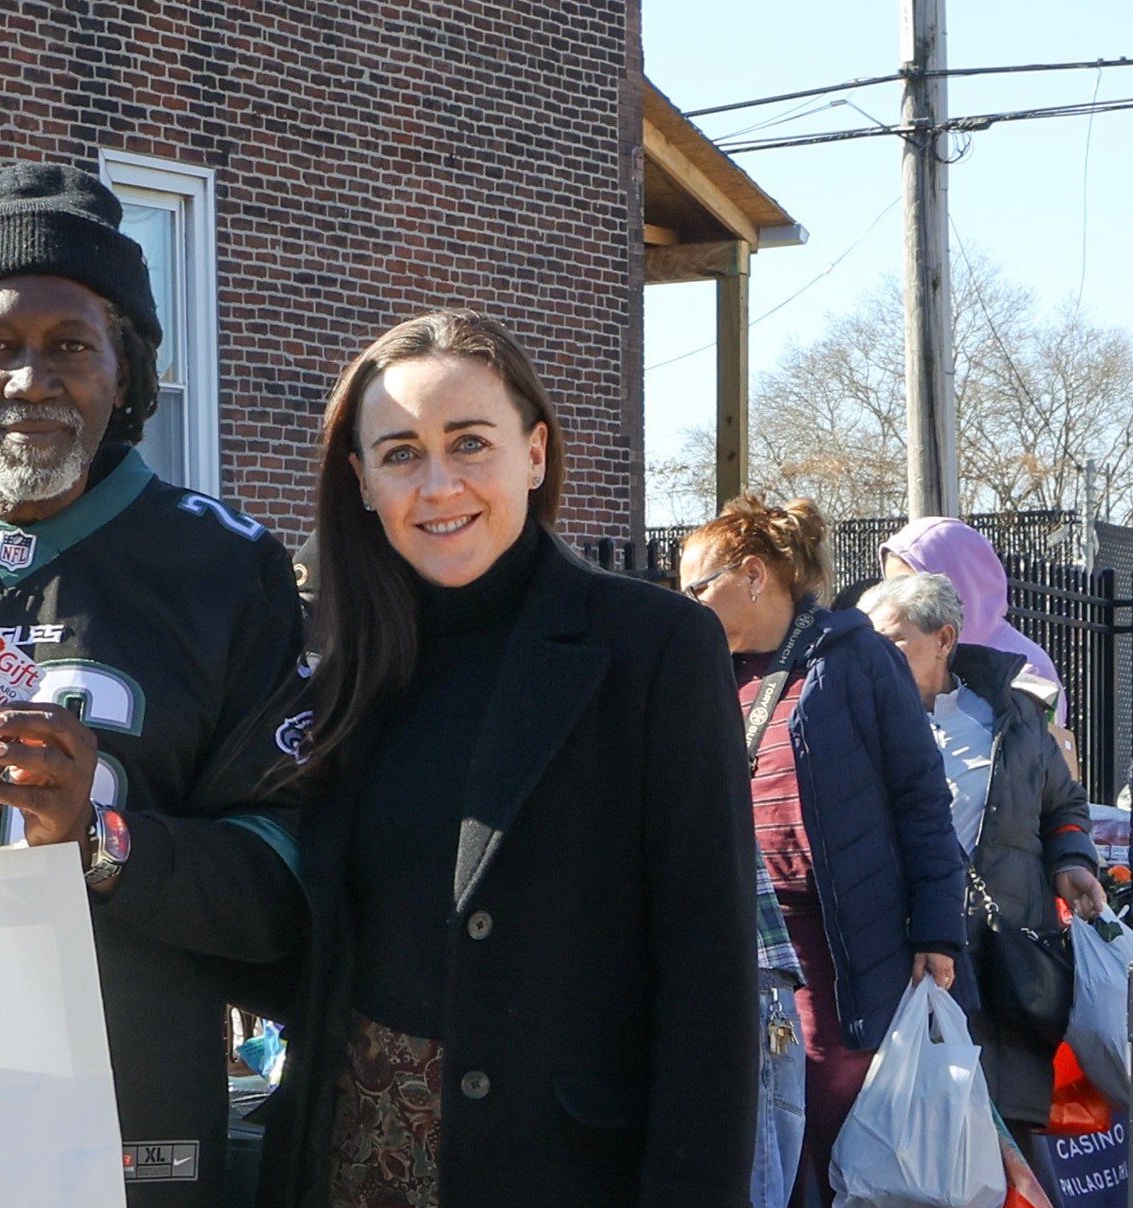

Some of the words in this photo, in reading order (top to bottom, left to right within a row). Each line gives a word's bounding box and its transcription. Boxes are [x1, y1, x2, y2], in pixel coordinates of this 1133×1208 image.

[2, 548, 27, 562] NFL
[779, 628, 802, 664] BURCH
[762, 682, 776, 708] TORY
[746, 725, 757, 747] BUR
[1056, 1123, 1125, 1160] CASINO
[145, 1147, 166, 1163] XL
